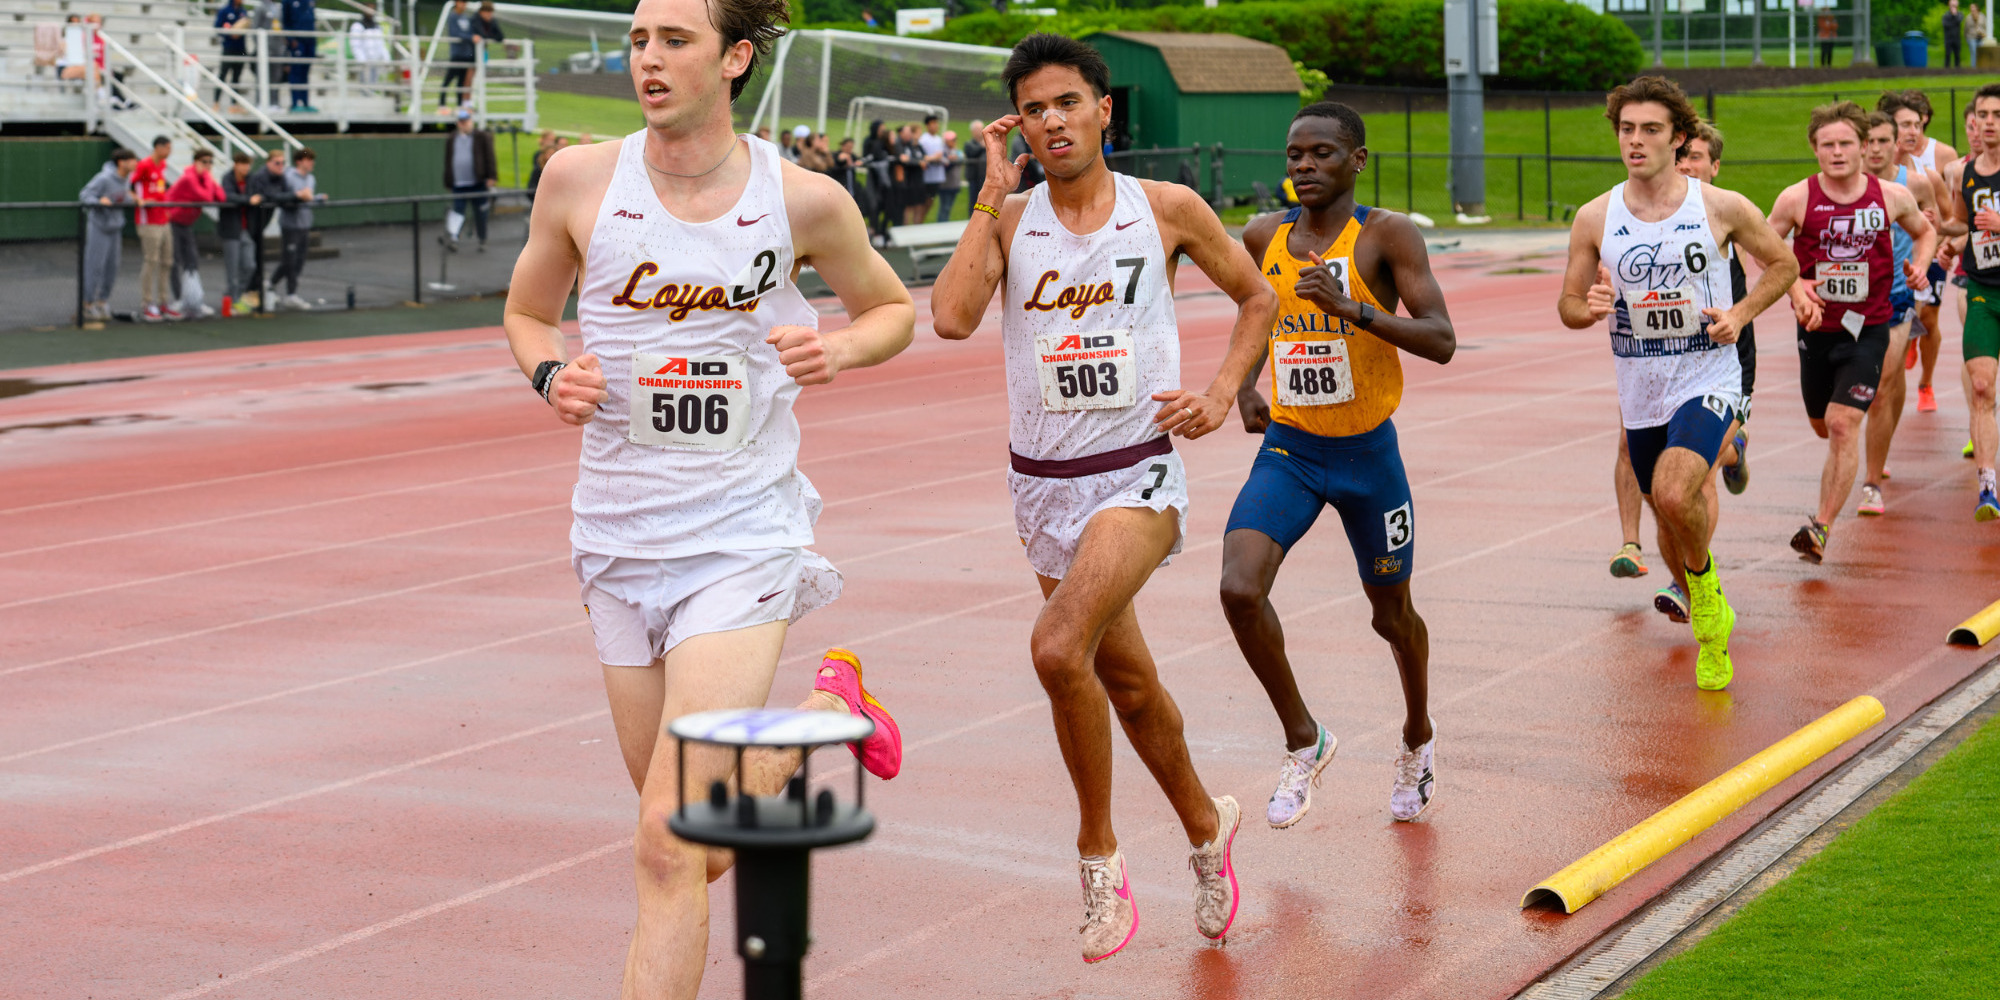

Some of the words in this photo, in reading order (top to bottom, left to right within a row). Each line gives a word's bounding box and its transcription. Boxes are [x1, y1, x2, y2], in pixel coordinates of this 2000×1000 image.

[613, 209, 644, 220] A10
[1858, 210, 1881, 229] 16
[1674, 224, 1701, 232] A10
[1684, 241, 1707, 274] 6
[1827, 263, 1858, 271] A10
[1115, 257, 1145, 305] 7
[1827, 278, 1857, 295] 616
[611, 261, 761, 322] Loyo
[1023, 269, 1115, 320] Loyo
[1641, 291, 1682, 302] A10
[1632, 299, 1691, 309] CHAMPIONSHIPS
[1646, 308, 1684, 331] 470
[1055, 334, 1115, 352] A10
[1287, 343, 1331, 356] A10
[1042, 348, 1128, 364] CHAMPIONSHIPS
[1279, 355, 1344, 365] CHAMPIONSHIPS
[653, 357, 729, 376] A10
[638, 376, 743, 390] CHAMPIONSHIPS
[1056, 362, 1119, 399] 503
[1289, 367, 1337, 395] 488
[652, 392, 729, 435] 506
[1141, 463, 1168, 500] 7
[1390, 509, 1409, 546] 3
